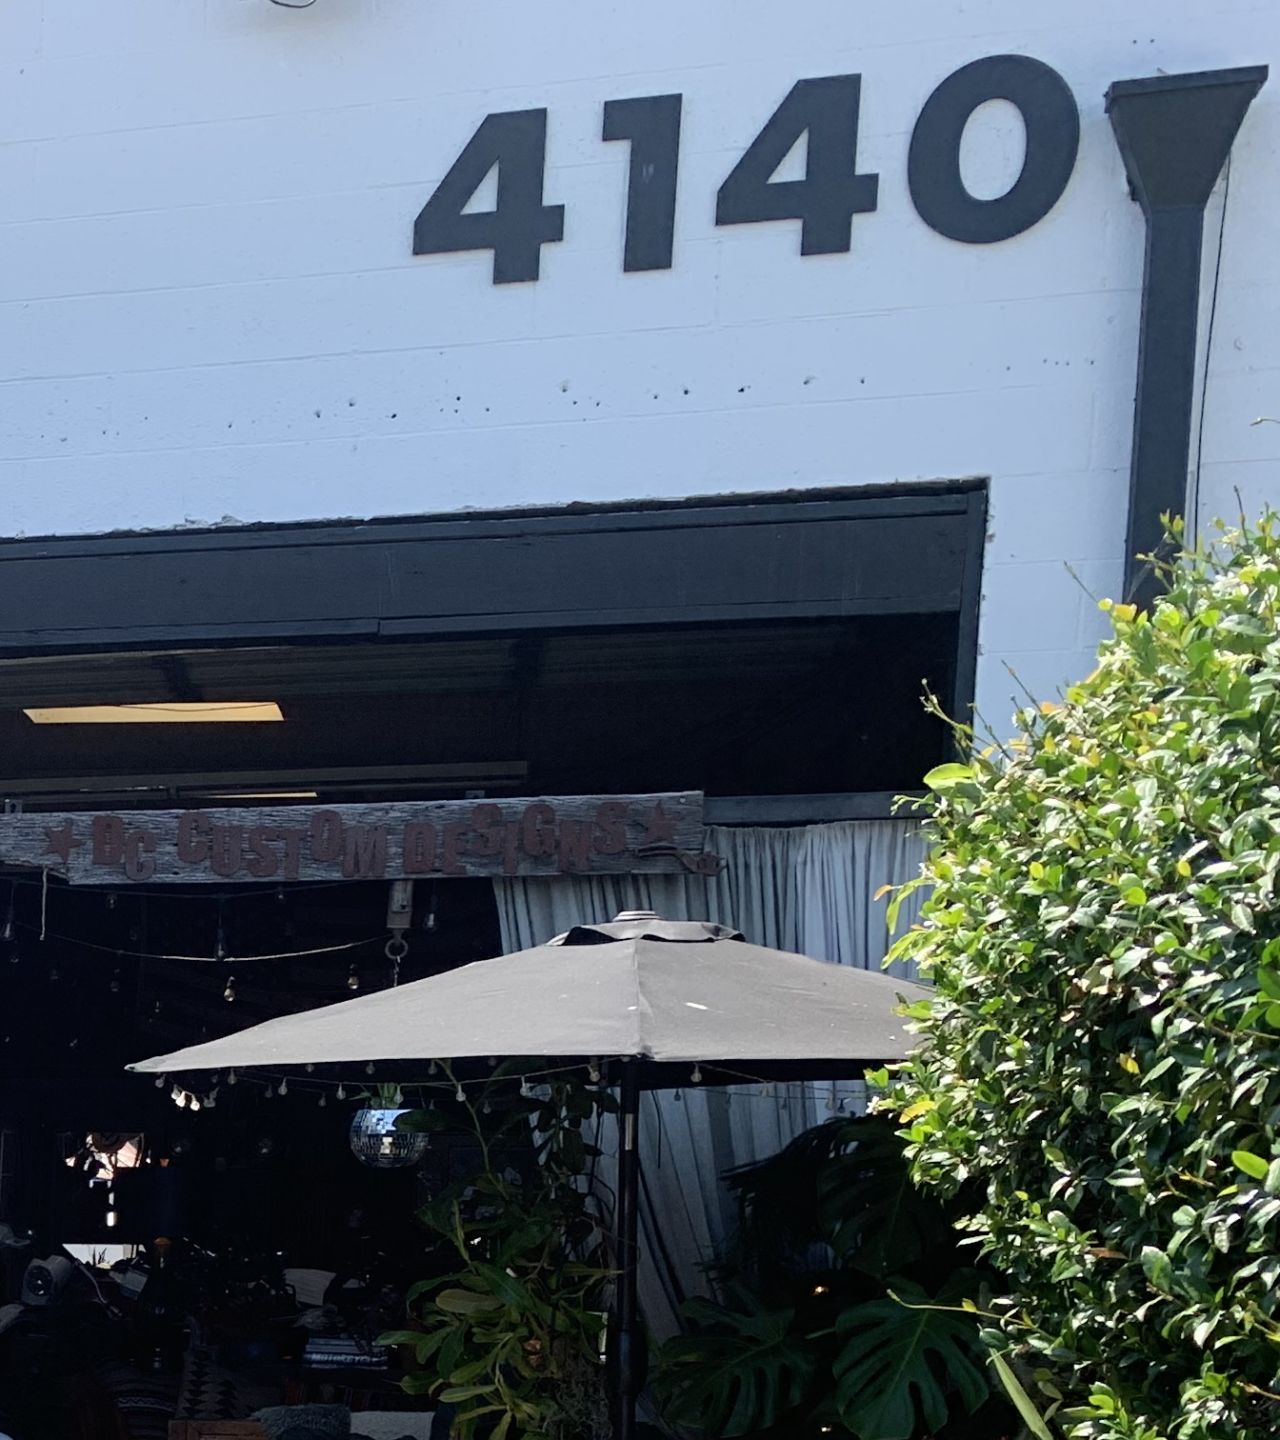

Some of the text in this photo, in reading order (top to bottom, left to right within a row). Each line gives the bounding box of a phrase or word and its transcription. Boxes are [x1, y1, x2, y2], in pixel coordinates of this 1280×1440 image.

[411, 53, 1081, 285] 4140
[176, 808, 387, 879] CUSTOM
[402, 800, 630, 875] DESIGNS
